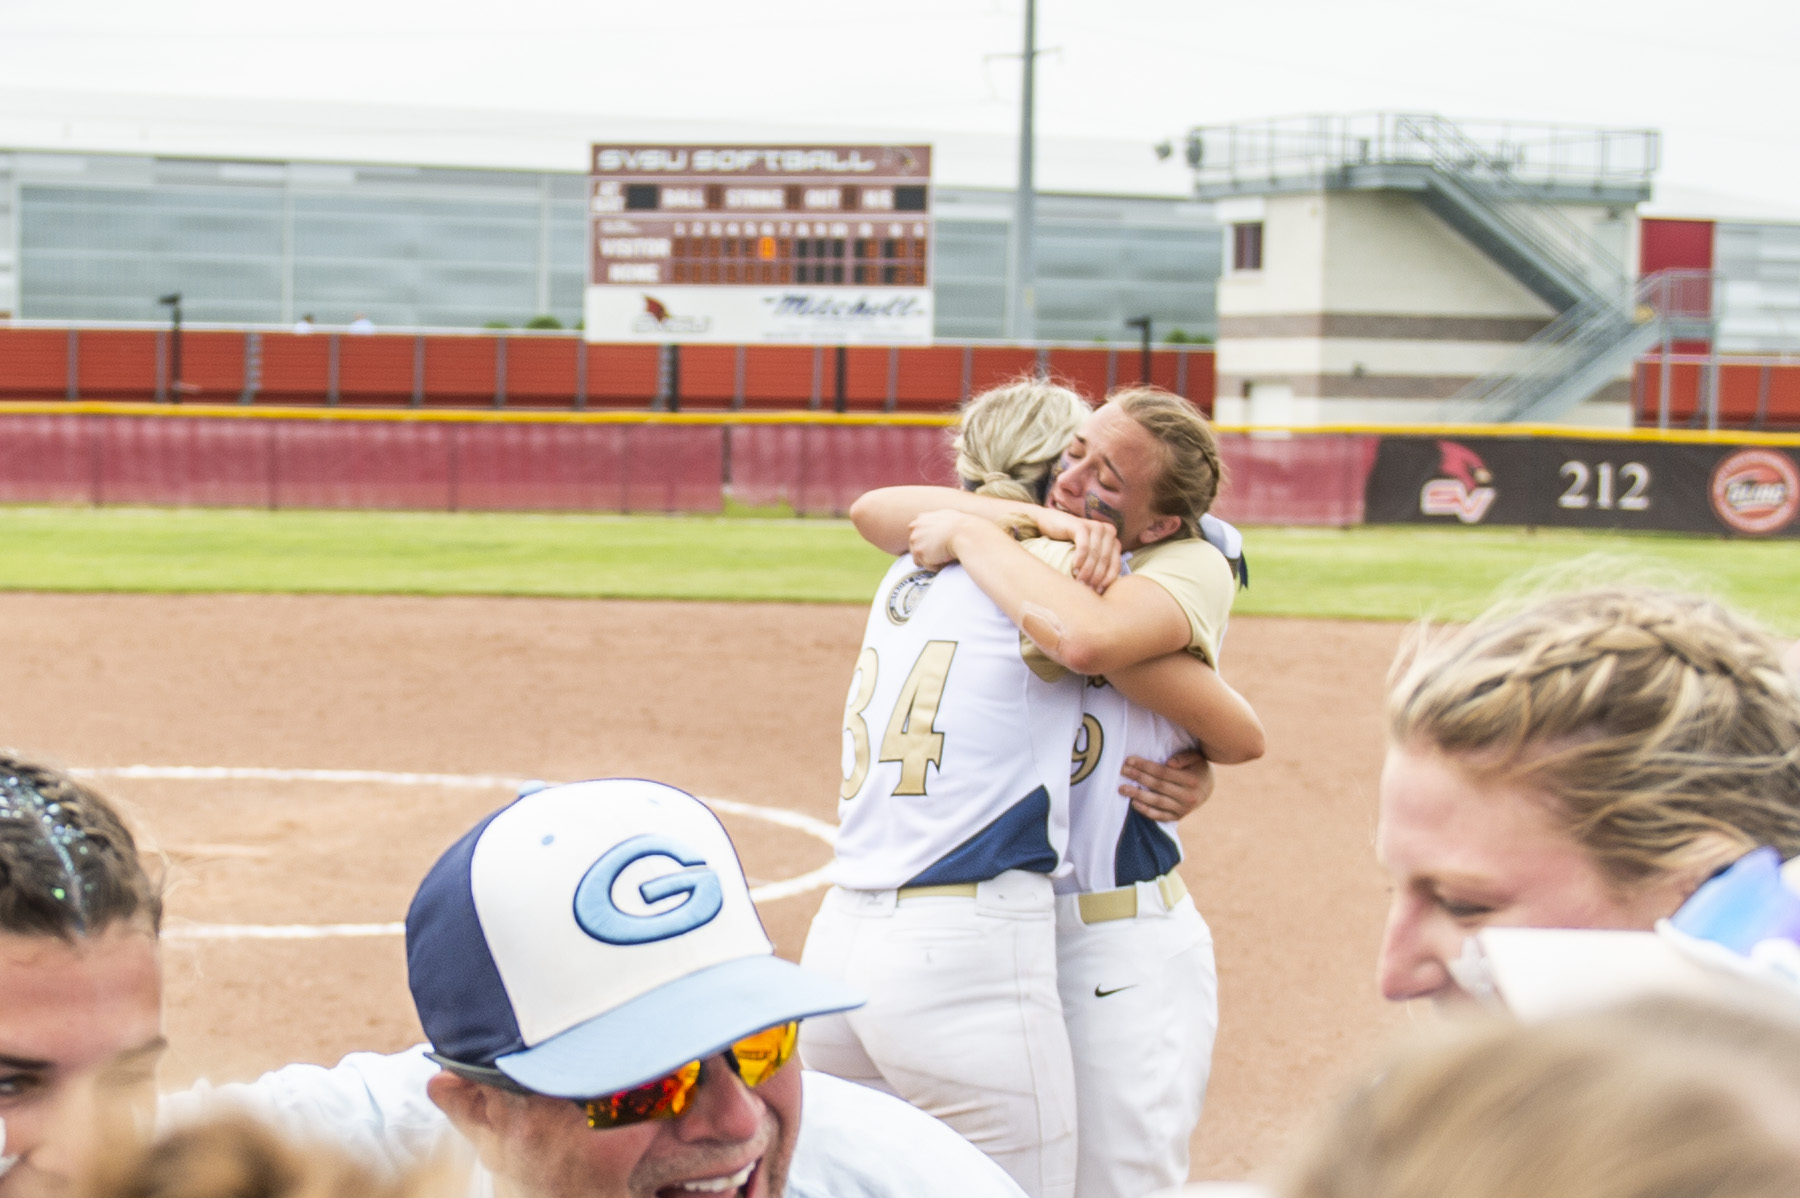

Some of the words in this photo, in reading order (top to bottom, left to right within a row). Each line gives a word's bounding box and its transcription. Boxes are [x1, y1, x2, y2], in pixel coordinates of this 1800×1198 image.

[691, 150, 877, 173] SOFTBALL
[1556, 460, 1652, 511] 212
[573, 833, 723, 946] G
